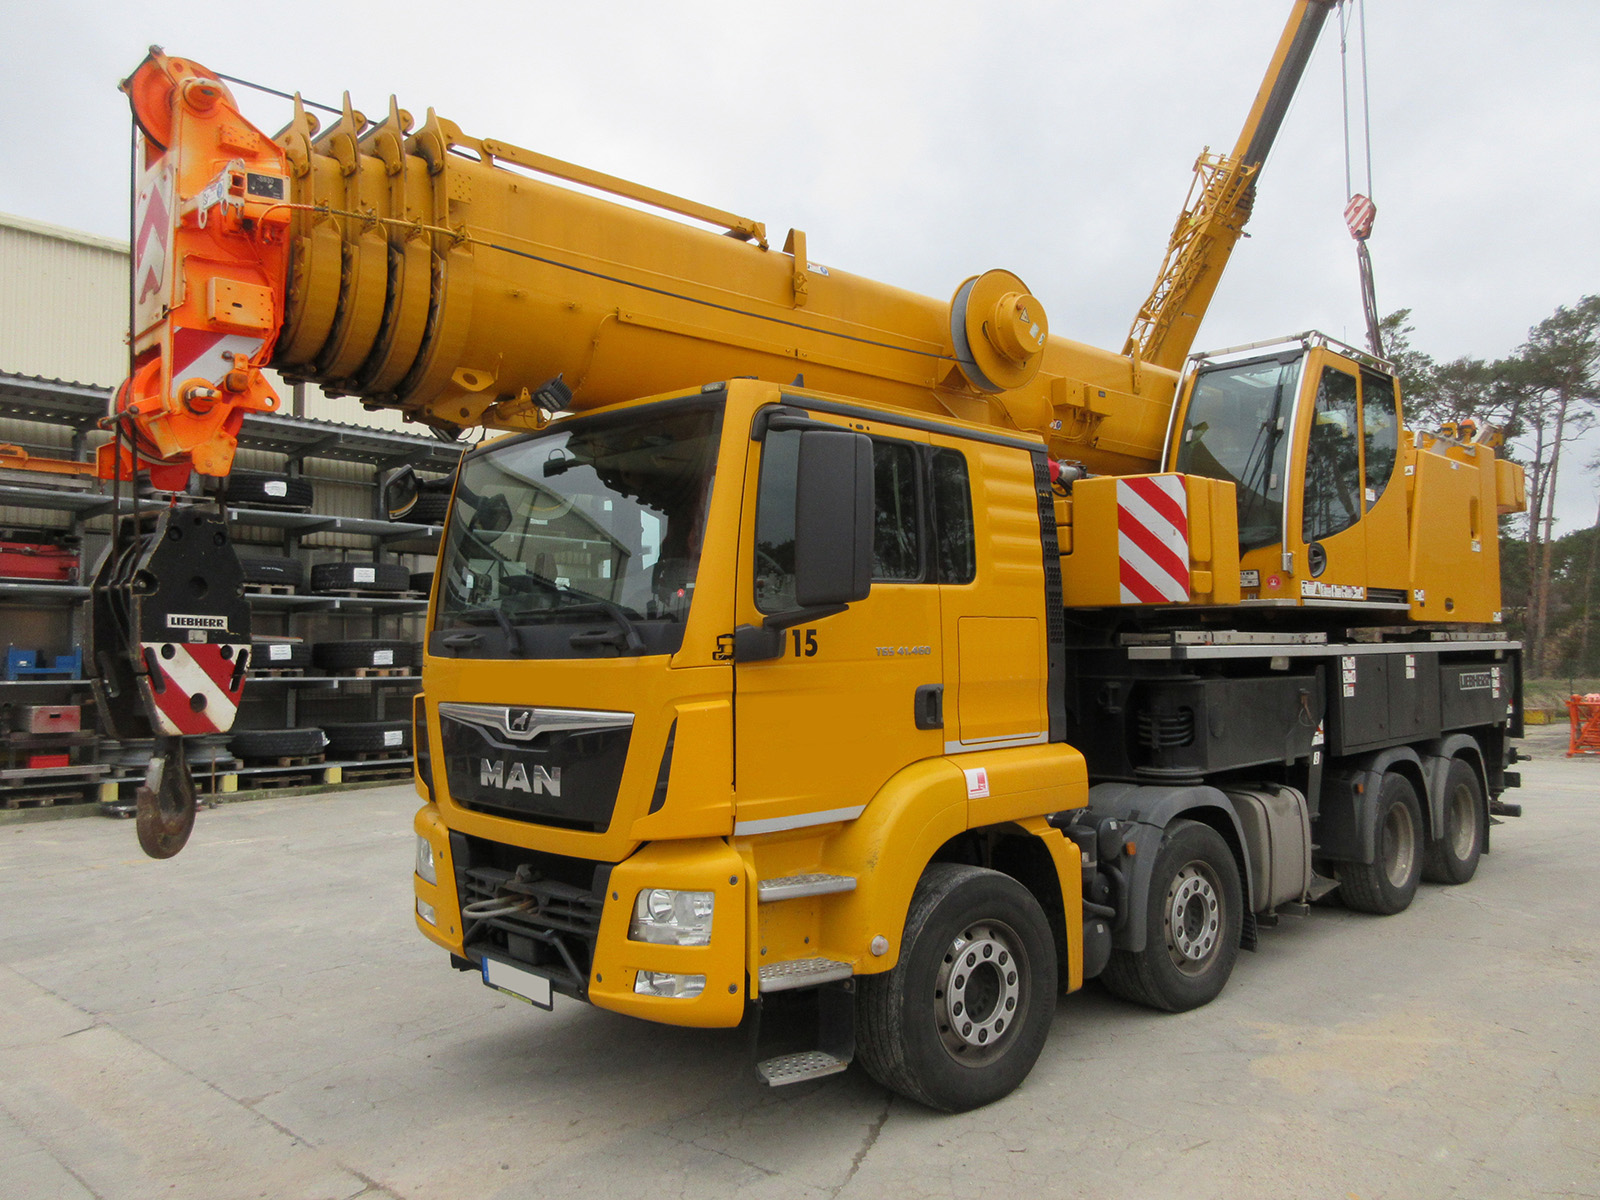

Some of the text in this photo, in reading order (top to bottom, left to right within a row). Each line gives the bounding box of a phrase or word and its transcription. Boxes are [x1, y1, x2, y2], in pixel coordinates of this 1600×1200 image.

[170, 616, 225, 628] LIEBHERR
[792, 629, 818, 657] 15
[897, 645, 932, 656] 41.460
[480, 757, 562, 798] MAN
